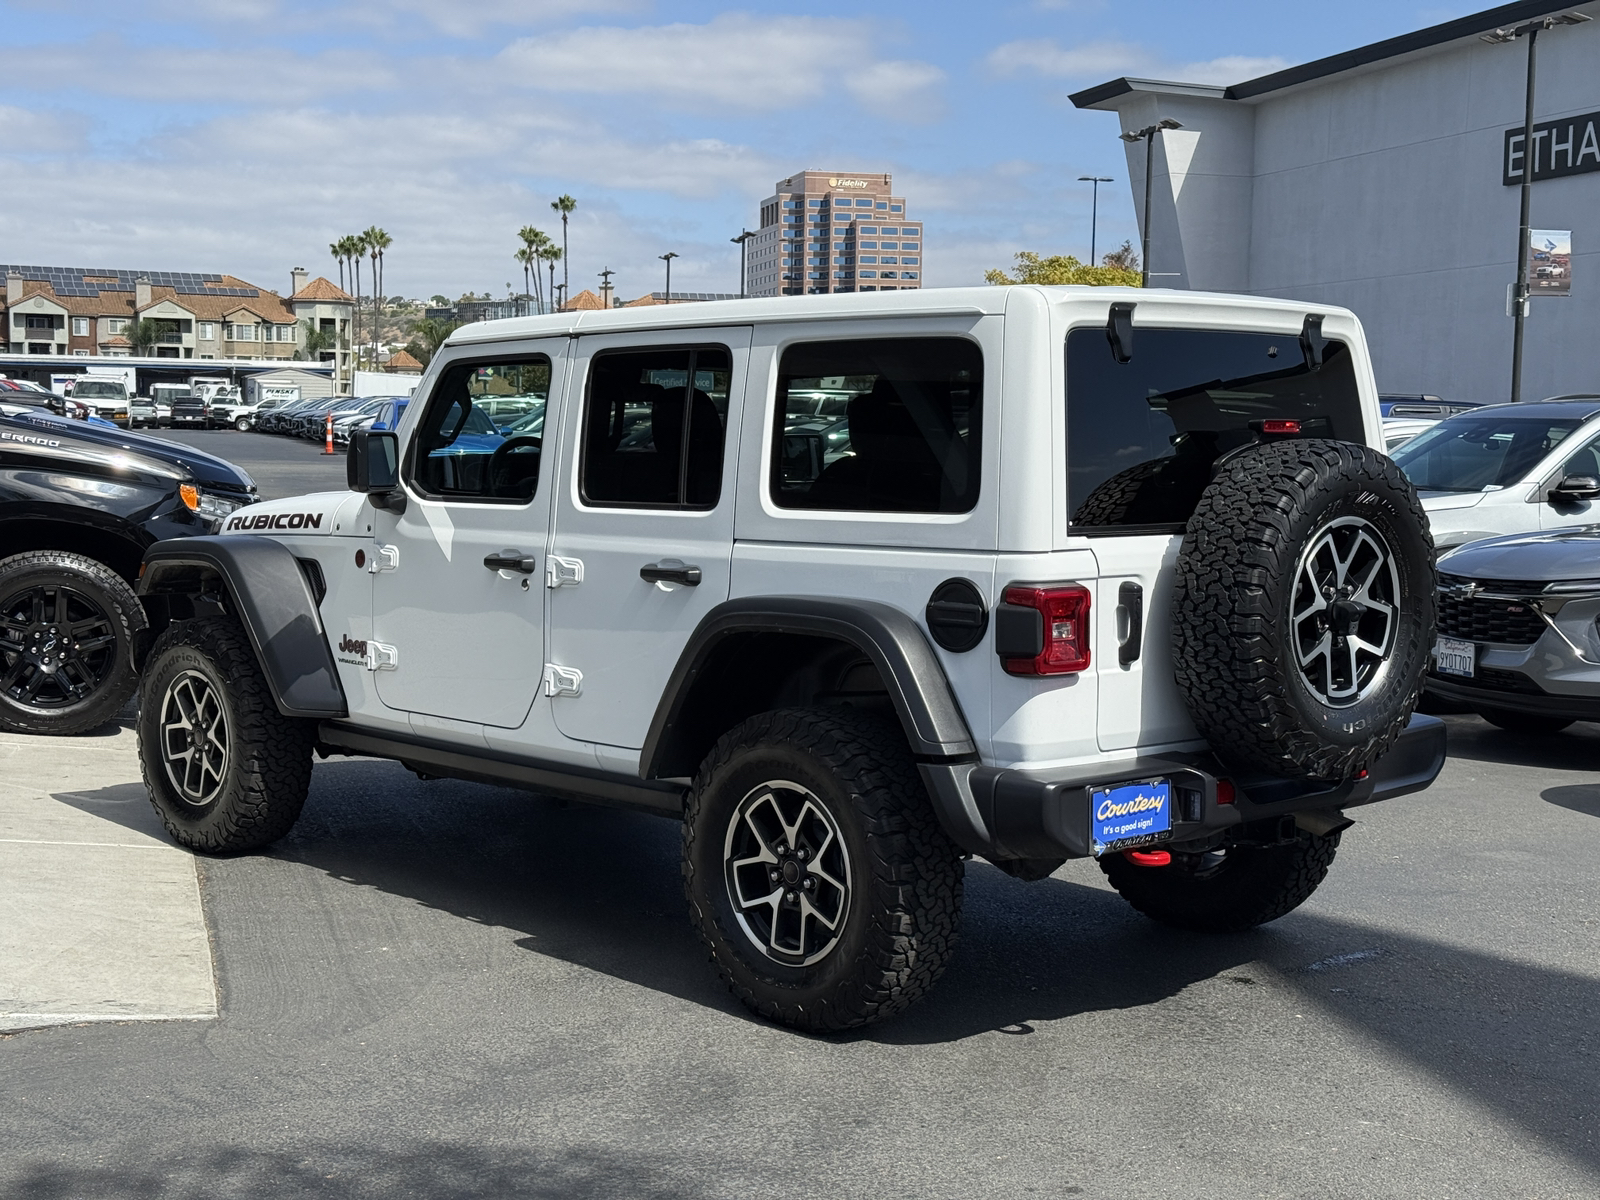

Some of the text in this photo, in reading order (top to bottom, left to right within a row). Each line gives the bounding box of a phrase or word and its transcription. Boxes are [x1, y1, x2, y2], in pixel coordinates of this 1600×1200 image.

[1508, 121, 1600, 177] ETHA
[837, 179, 868, 189] Fidelity
[654, 378, 683, 387] Certified
[226, 513, 324, 531] RUBICON
[339, 633, 368, 659] Jeep
[1096, 793, 1166, 821] Courtesy
[1103, 825, 1114, 835] It's
[1121, 820, 1137, 835] good
[1137, 817, 1153, 831] sign!
